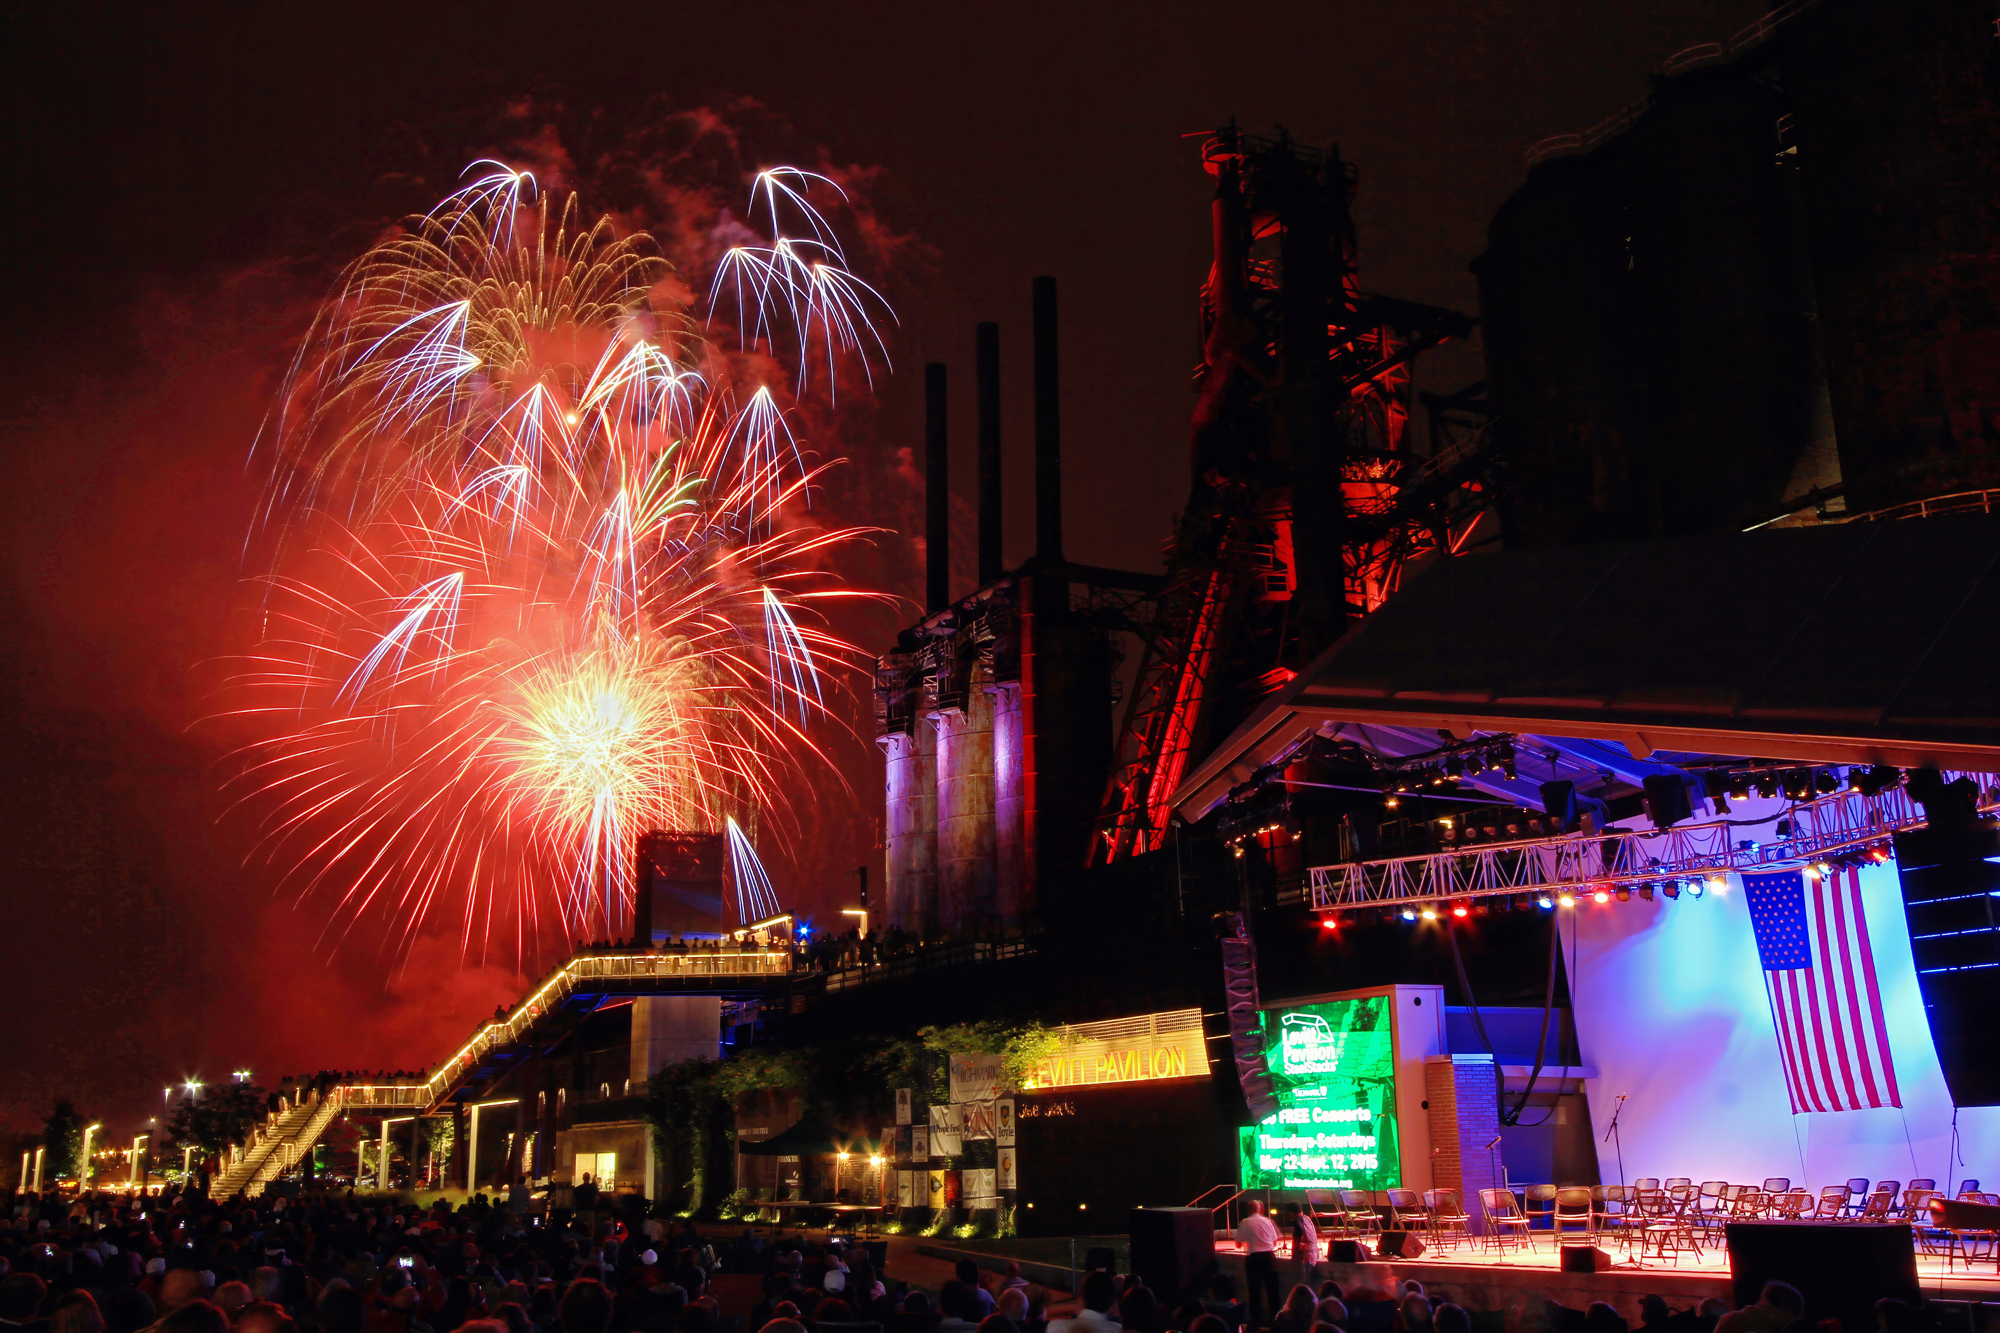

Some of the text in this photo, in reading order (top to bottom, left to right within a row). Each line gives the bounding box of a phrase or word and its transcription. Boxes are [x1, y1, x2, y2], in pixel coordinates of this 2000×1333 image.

[1282, 1026, 1317, 1046] Levitt
[1283, 1043, 1336, 1063] Pavilion
[1096, 1045, 1187, 1082] PAVILION
[1279, 1108, 1310, 1124] FREE
[1313, 1107, 1372, 1123] Concerts
[998, 1126, 1015, 1141] Boyle
[1260, 1155, 1282, 1172] May
[1331, 1154, 1348, 1171] 12,
[1350, 1153, 1378, 1169] 2015
